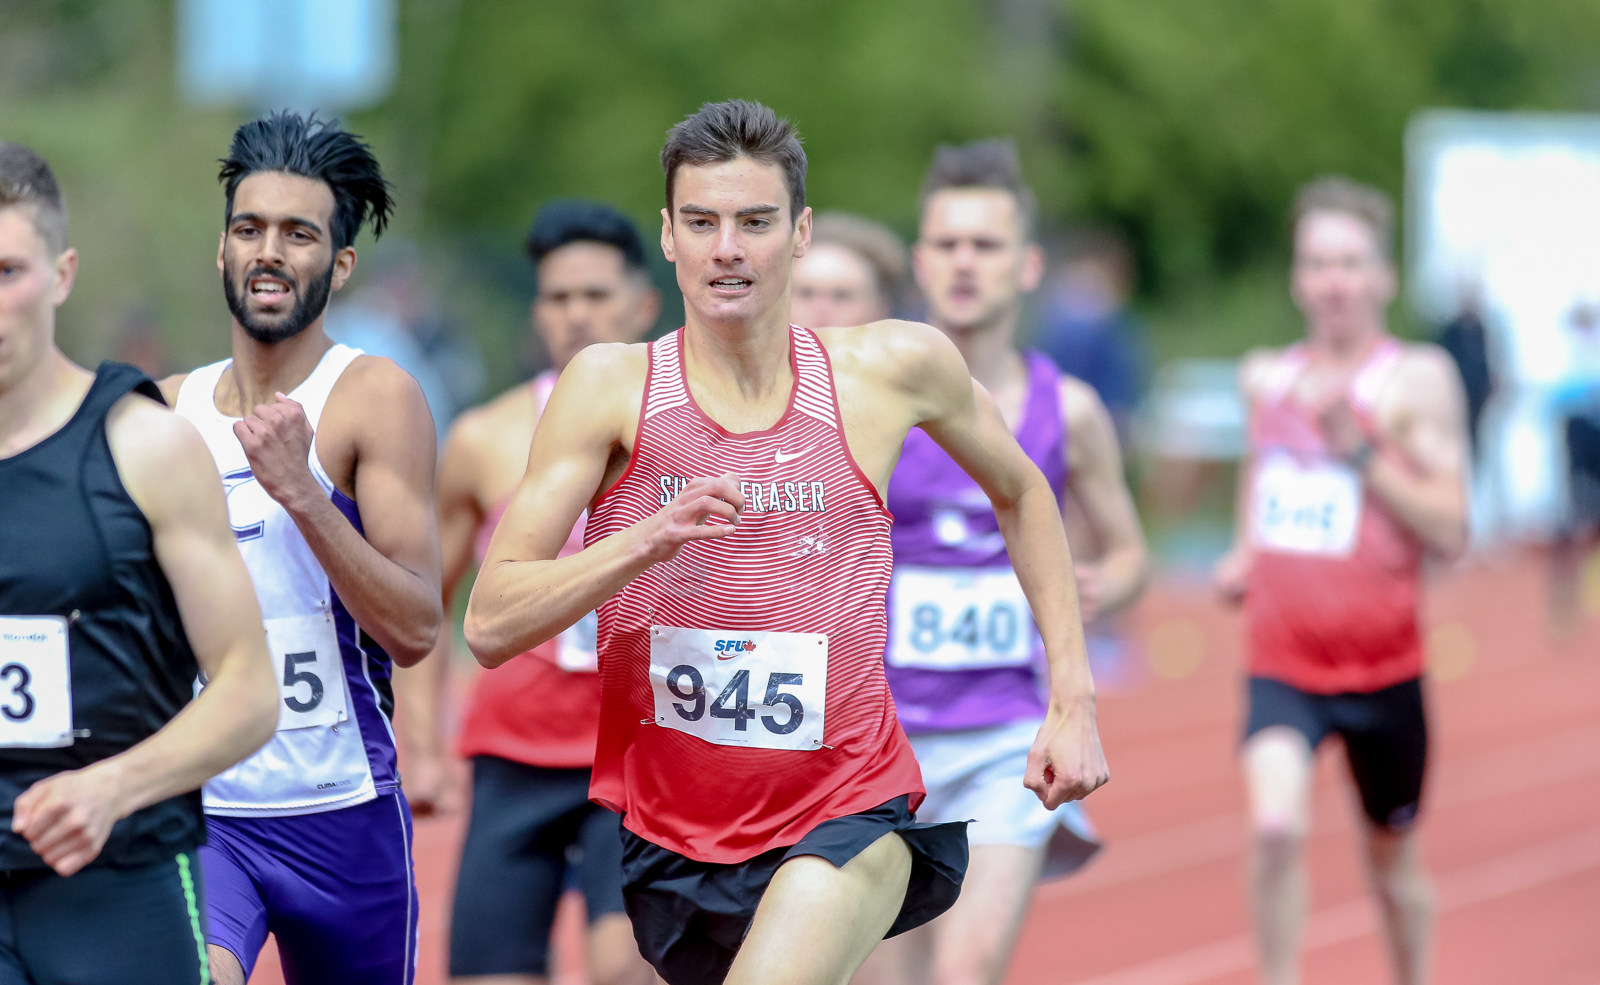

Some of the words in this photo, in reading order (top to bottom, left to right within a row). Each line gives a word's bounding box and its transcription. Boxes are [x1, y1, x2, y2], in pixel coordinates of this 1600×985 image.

[739, 480, 827, 513] FRASER
[713, 639, 747, 653] SFU
[909, 601, 1017, 653] 840
[0, 664, 34, 720] 3
[666, 664, 804, 735] 945
